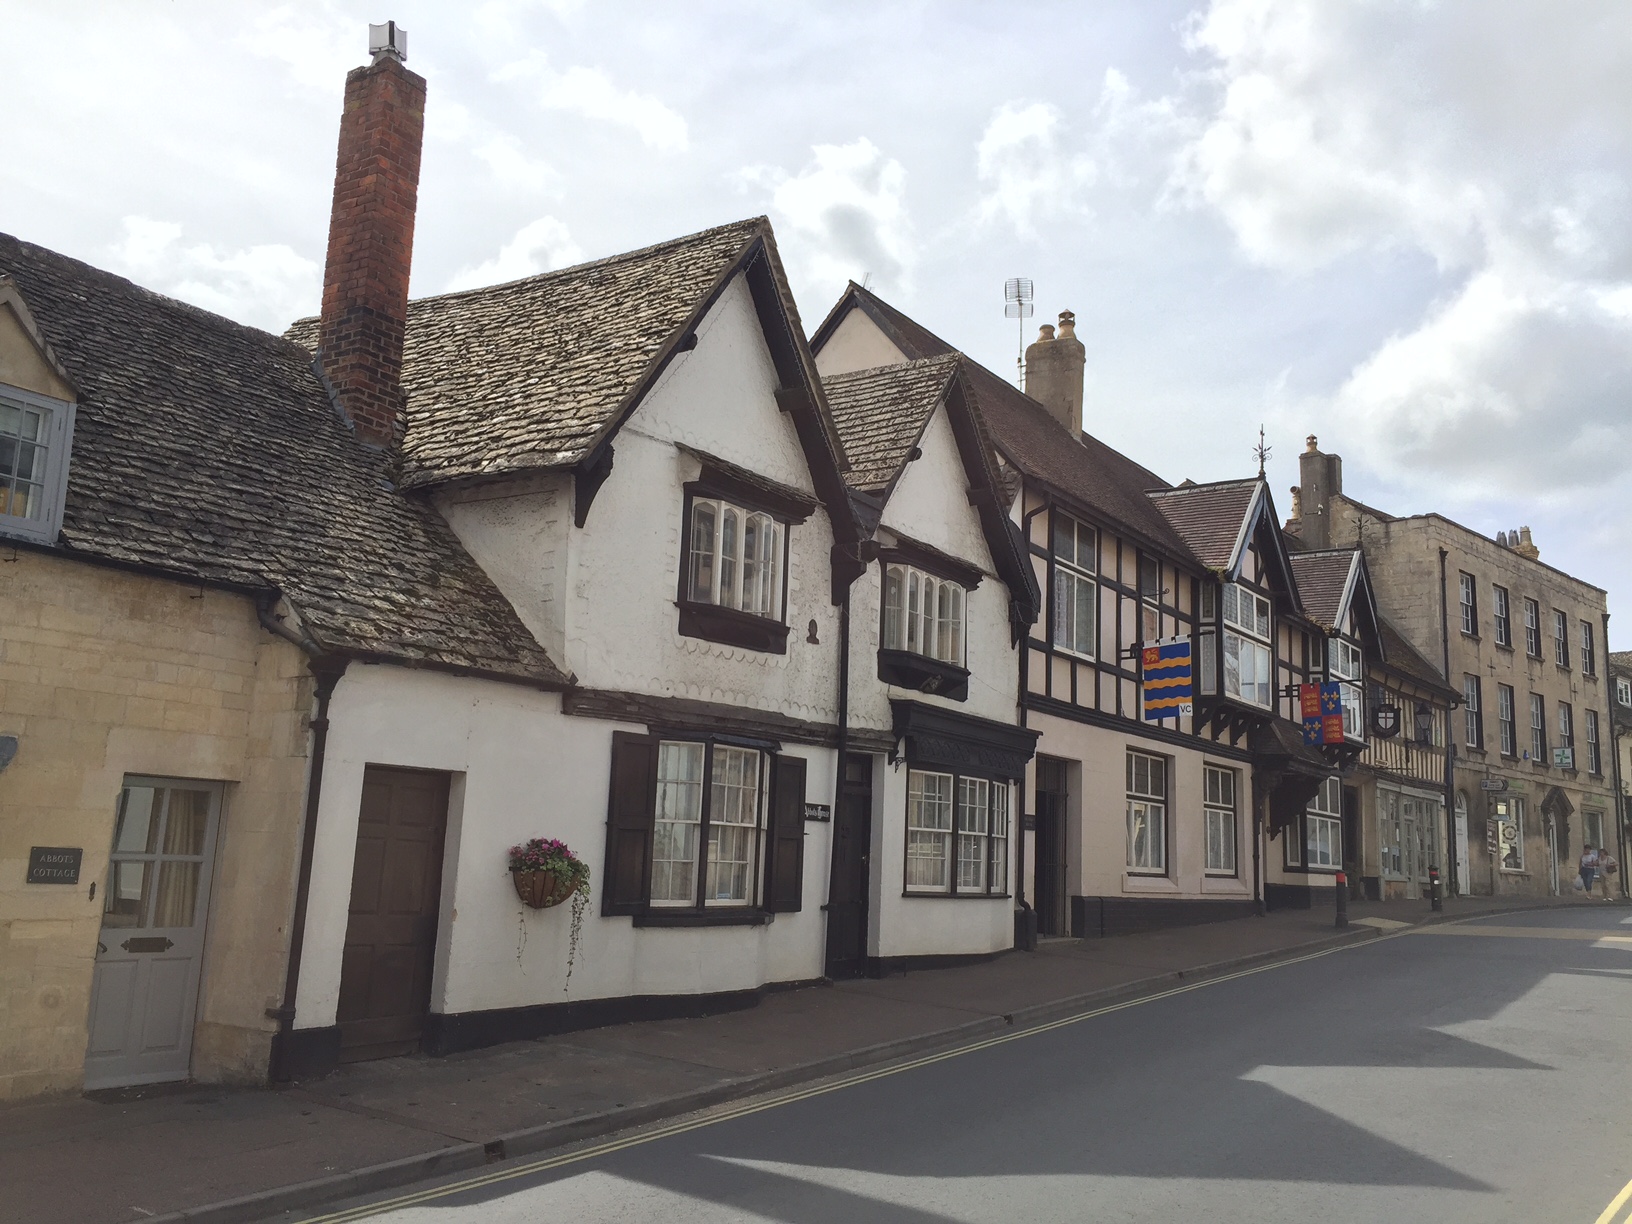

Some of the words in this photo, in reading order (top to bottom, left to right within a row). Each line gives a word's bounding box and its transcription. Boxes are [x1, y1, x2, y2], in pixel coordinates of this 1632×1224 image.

[1180, 705, 1192, 713] VC
[40, 854, 74, 864] ABBOTS
[33, 868, 76, 878] COTTAGE
